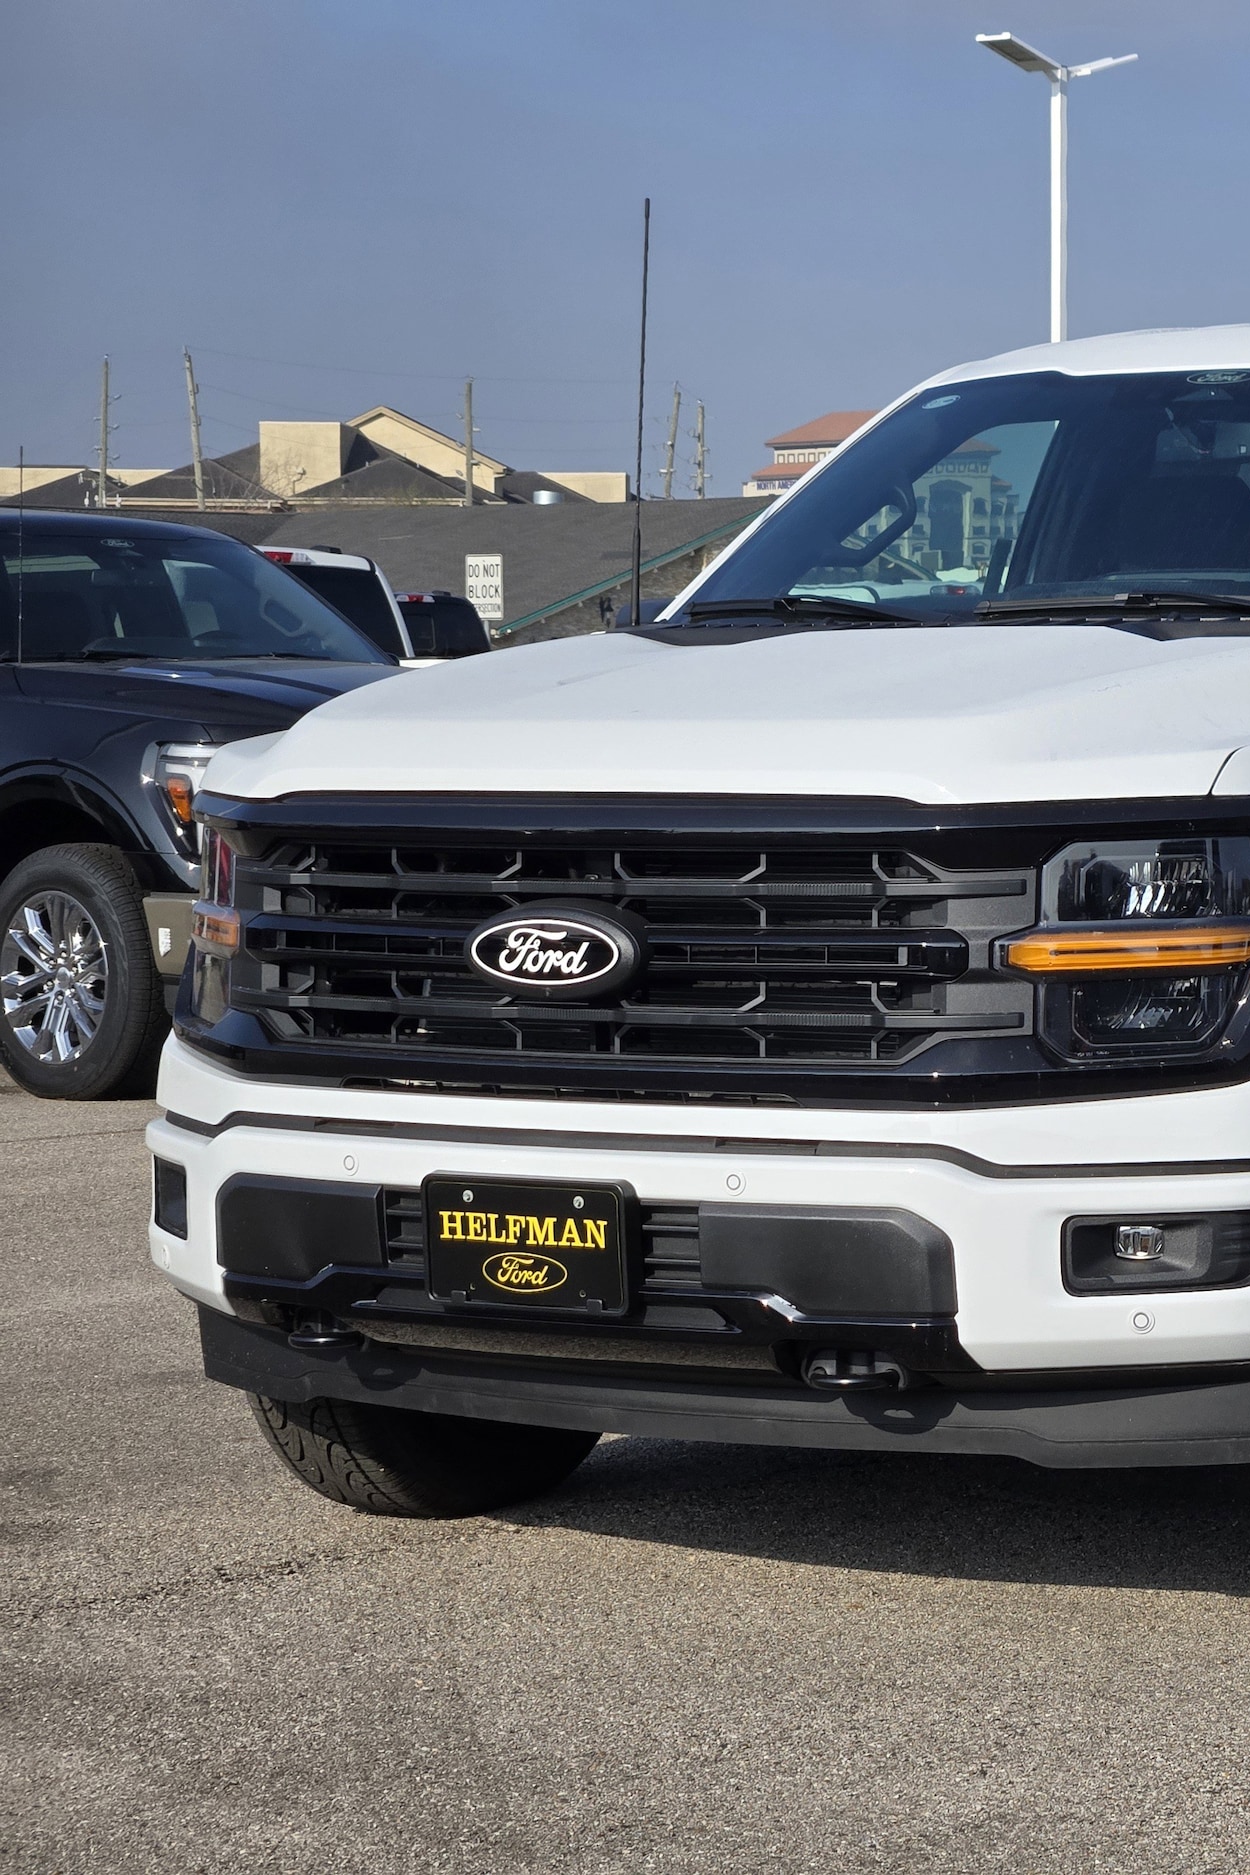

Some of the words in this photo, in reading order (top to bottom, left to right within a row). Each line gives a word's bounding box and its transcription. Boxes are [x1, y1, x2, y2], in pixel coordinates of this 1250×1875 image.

[1197, 371, 1247, 382] Ford
[757, 480, 777, 490] NORTH
[468, 564, 480, 577] DO
[483, 564, 500, 577] NOT
[468, 585, 501, 598] BLOCK
[499, 928, 590, 974] Ford
[438, 1210, 608, 1249] HELFMAN
[497, 1256, 549, 1285] Ford
